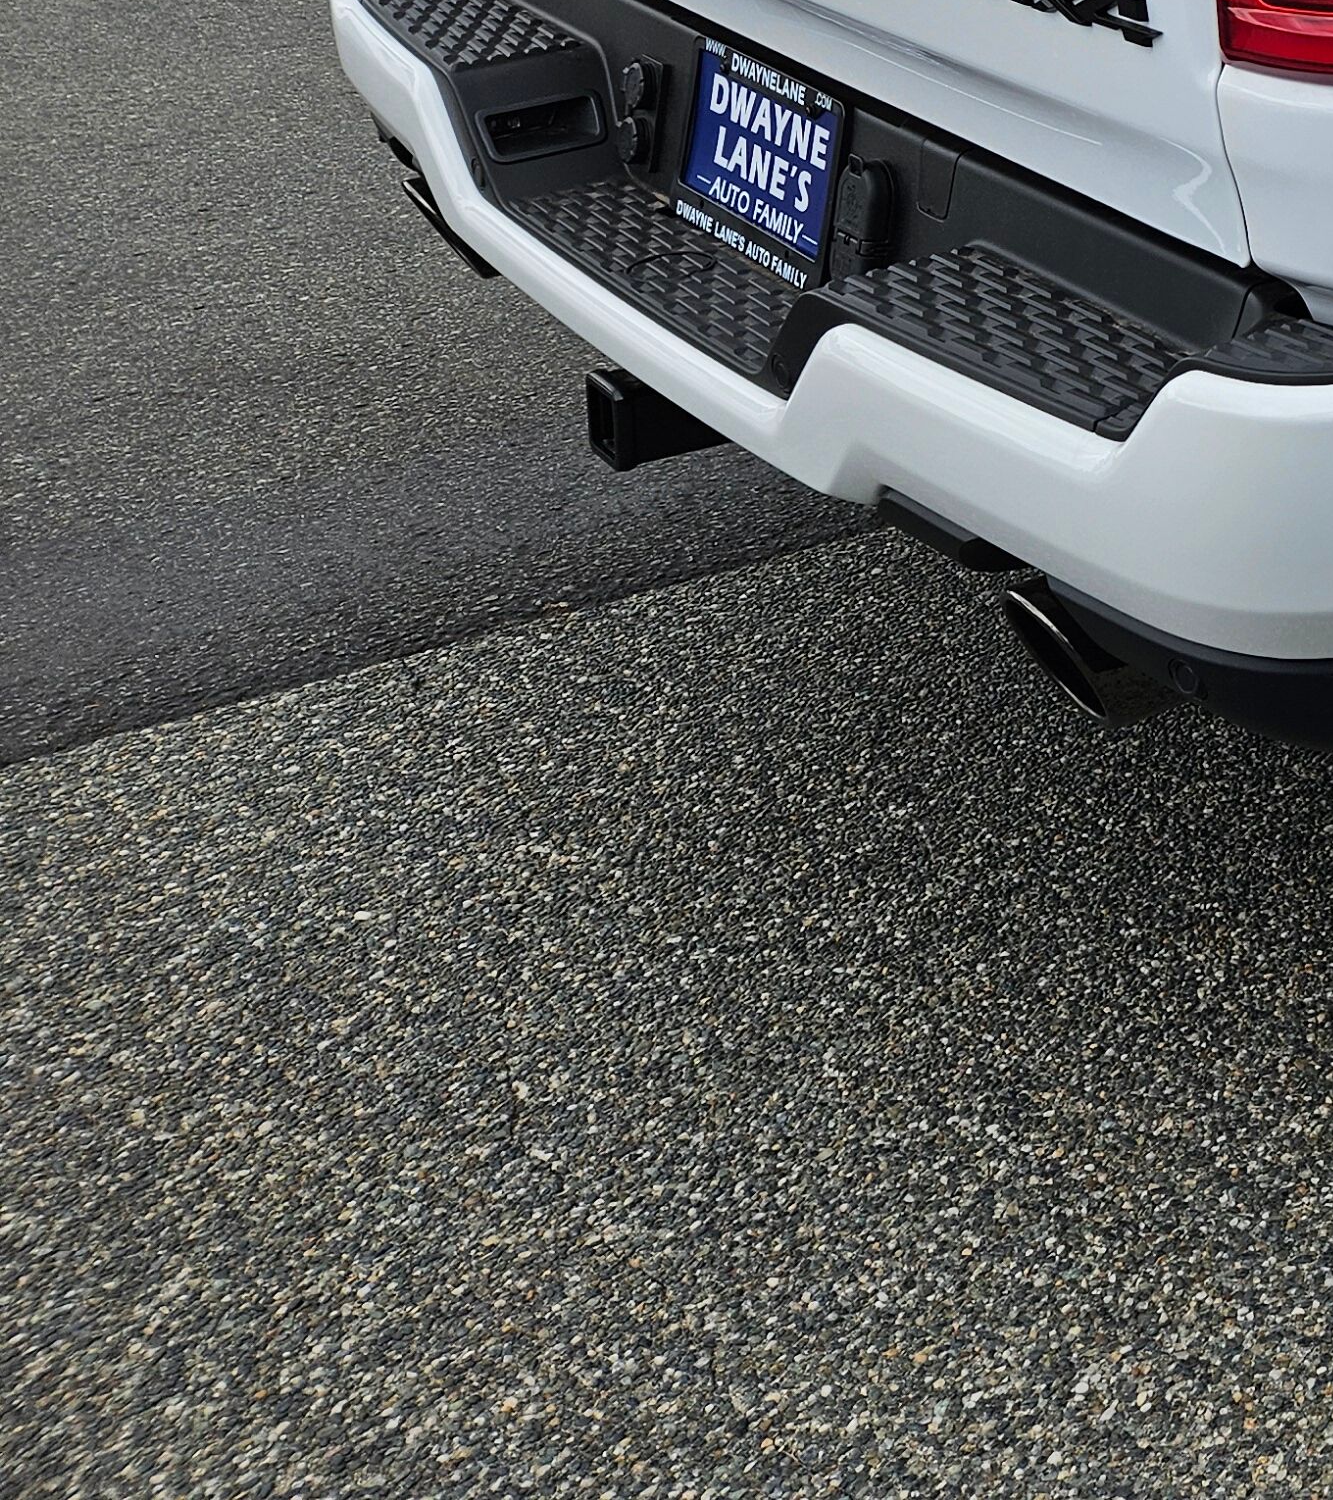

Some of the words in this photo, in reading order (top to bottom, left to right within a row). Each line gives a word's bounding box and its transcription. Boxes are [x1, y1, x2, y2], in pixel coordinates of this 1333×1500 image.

[709, 72, 831, 171] DWAYNE
[731, 53, 807, 106] DWAYNELANE
[708, 176, 750, 214] AUTO
[753, 199, 804, 244] FAMILY
[713, 125, 813, 213] LANE'S
[675, 199, 713, 234] DWAYNE
[714, 220, 746, 252] LANE'S
[744, 240, 771, 267] AUTO
[770, 255, 808, 290] FAMILY
